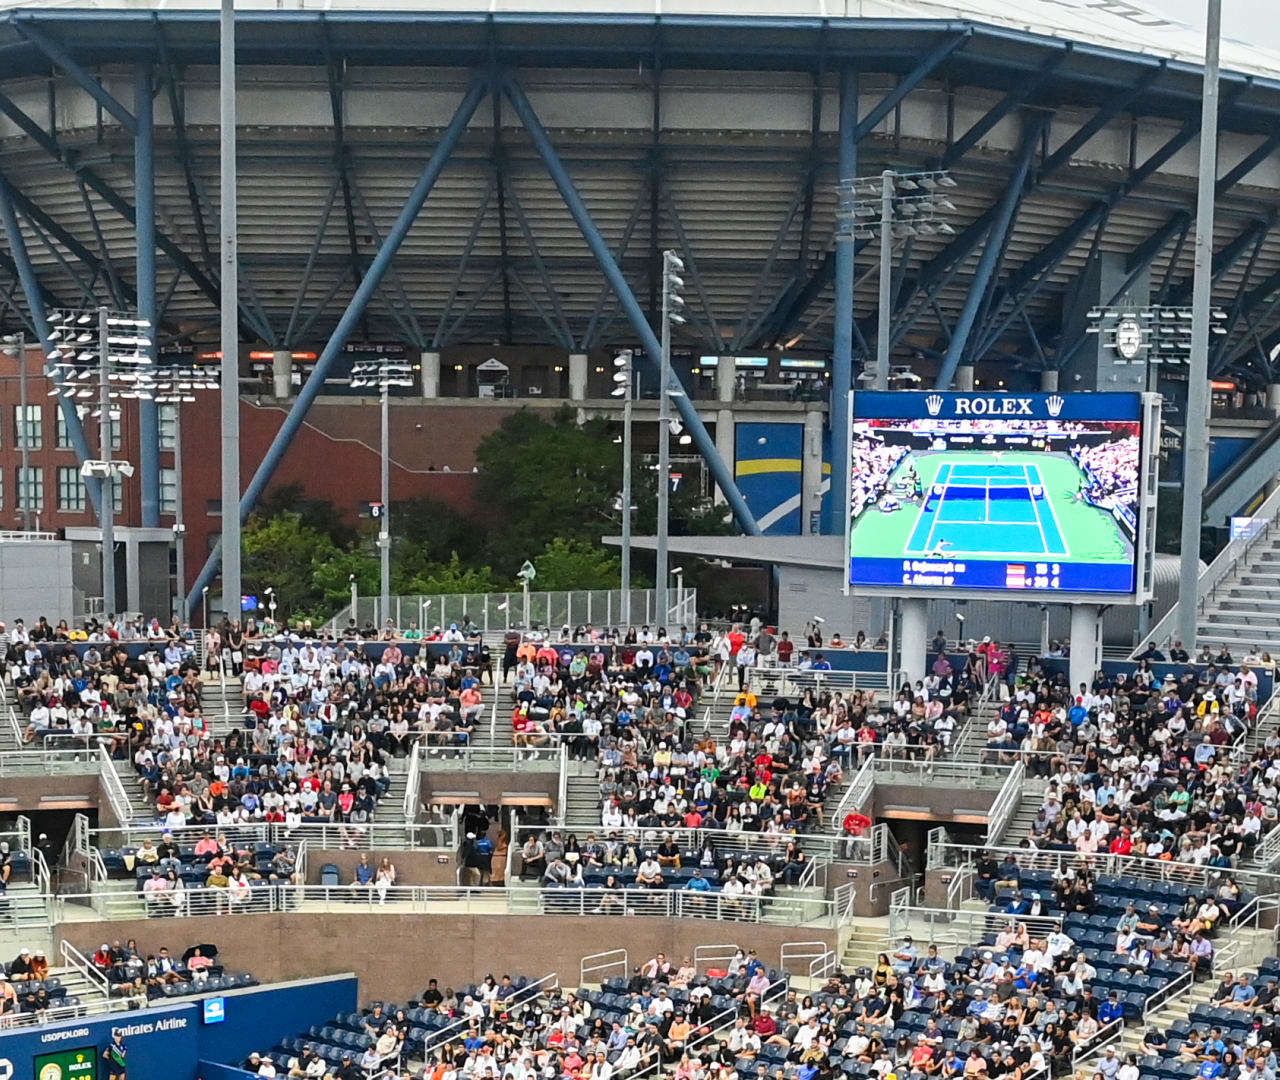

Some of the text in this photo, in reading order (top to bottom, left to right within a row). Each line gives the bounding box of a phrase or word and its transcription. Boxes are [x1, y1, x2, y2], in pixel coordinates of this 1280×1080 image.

[954, 397, 1034, 415] ROLEX
[671, 478, 679, 491] 7
[372, 506, 380, 517] 6
[1051, 563, 1060, 575] 3
[1050, 576, 1060, 588] 4
[155, 1017, 188, 1033] Airline
[41, 1028, 89, 1043] USOPEN.ORG
